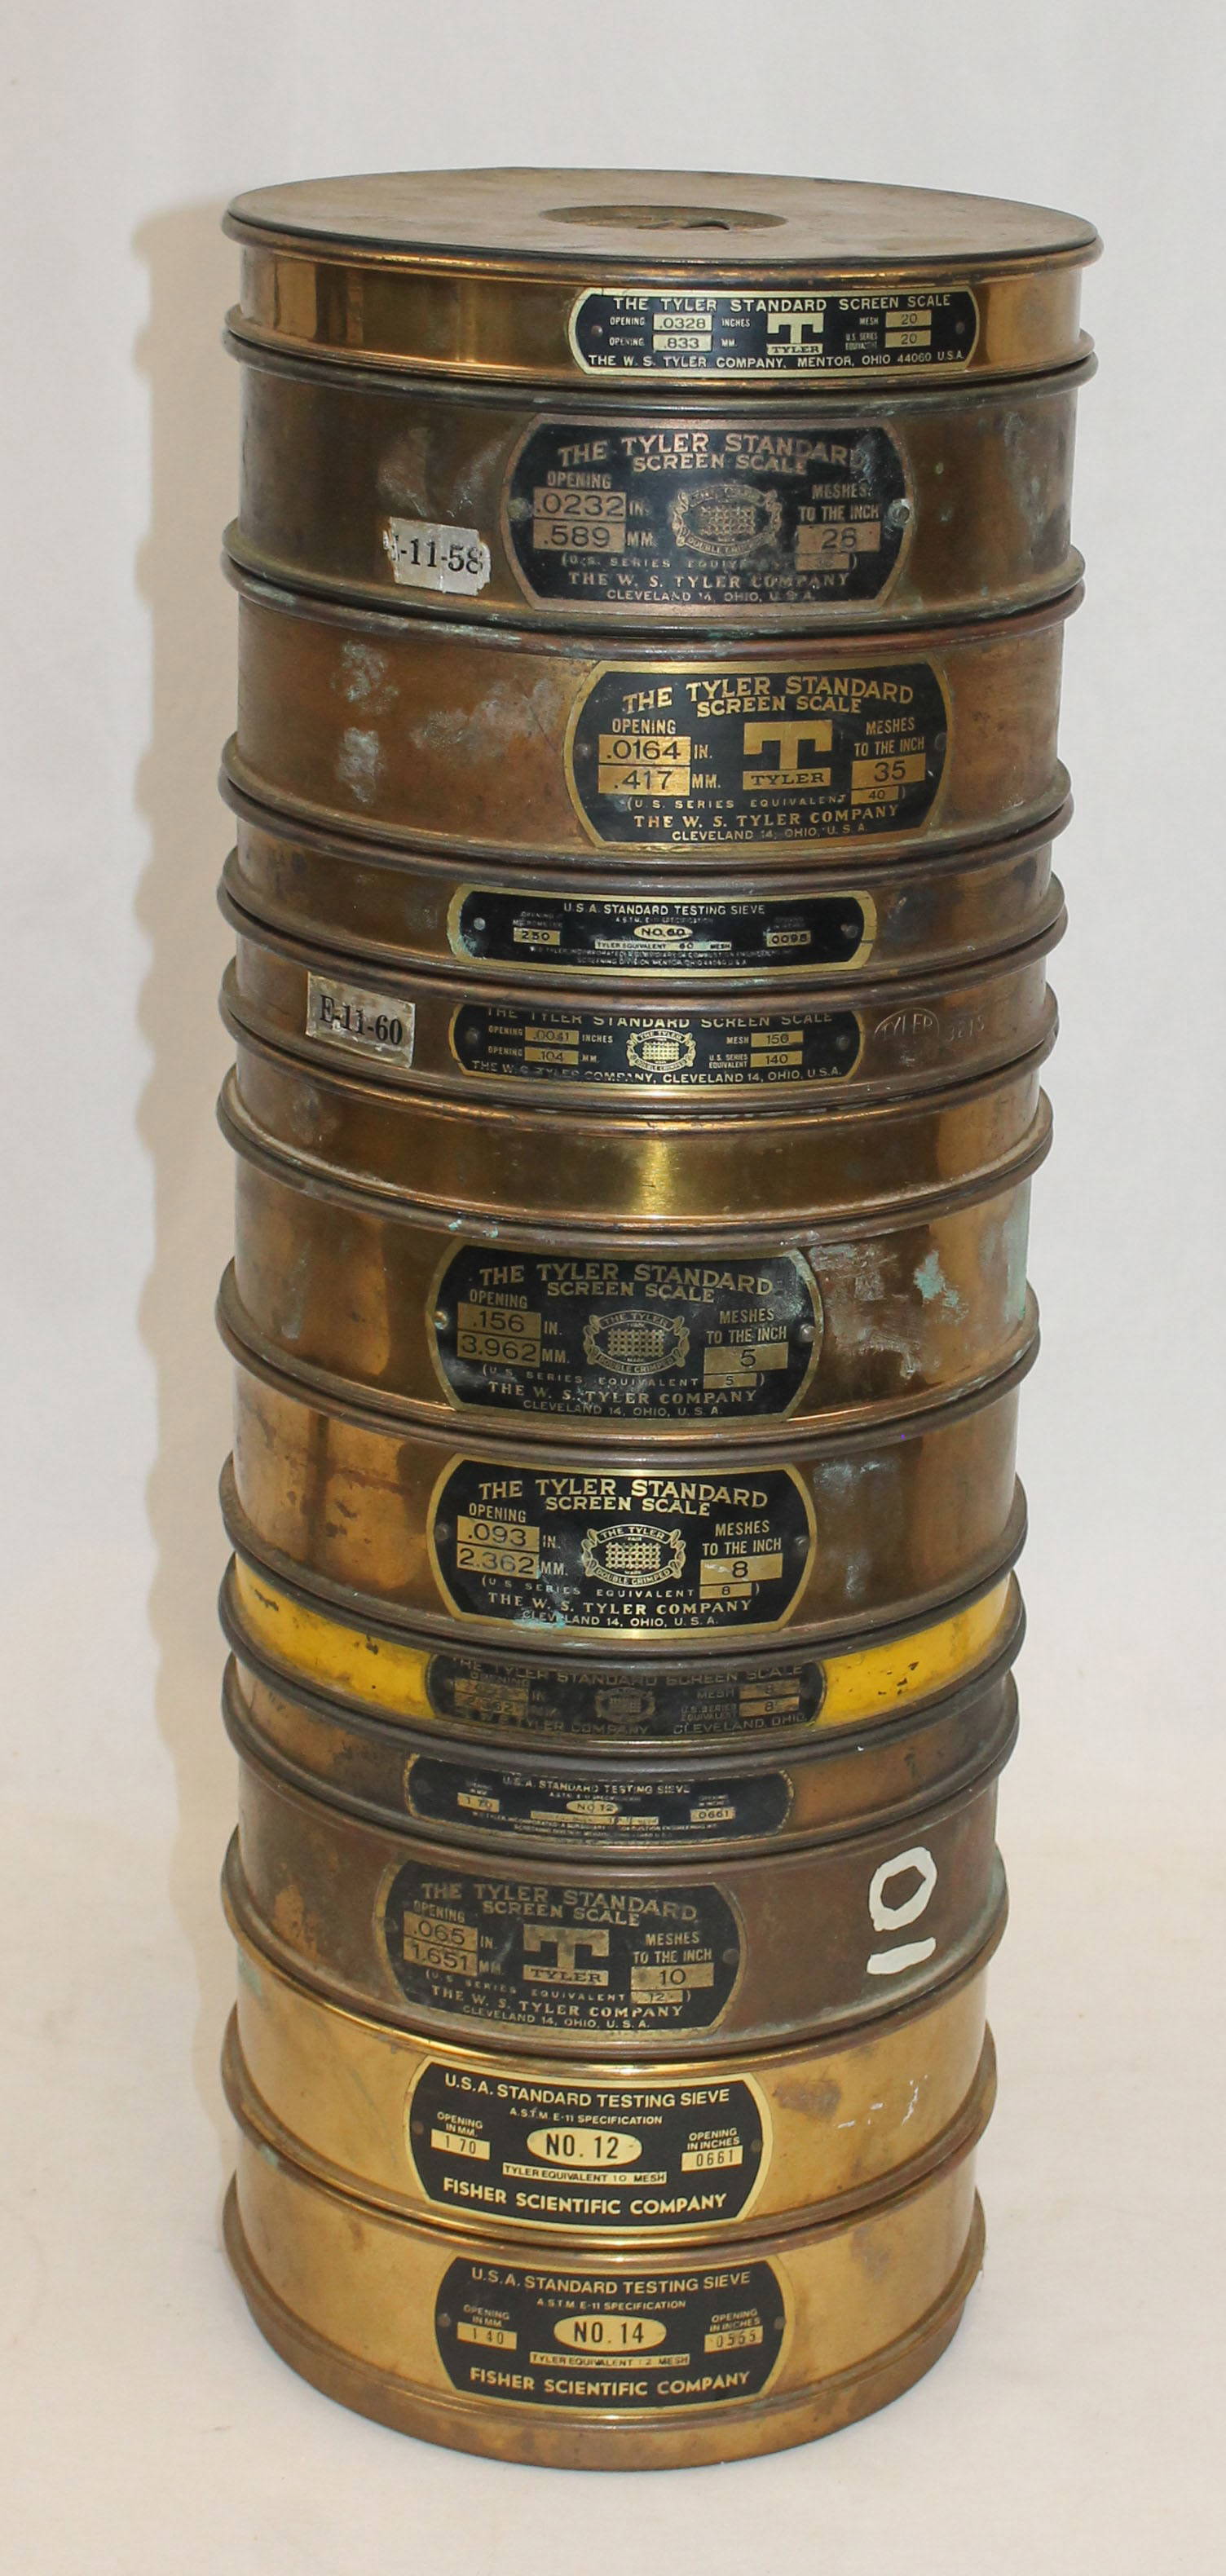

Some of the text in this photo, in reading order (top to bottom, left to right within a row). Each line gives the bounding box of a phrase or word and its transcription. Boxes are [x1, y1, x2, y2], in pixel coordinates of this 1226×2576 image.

[613, 295, 950, 312] THE TYLER STANDARD SCREEN SCALE
[610, 317, 750, 329] OPENING .0328 INCHES
[859, 312, 917, 325] MESH 20
[900, 333, 917, 345] 20
[589, 353, 931, 368] THE TYLER OHIO 44060
[558, 434, 709, 466] THE TYLER
[633, 457, 808, 475] SCREEN SCALE
[546, 471, 611, 488] OPENING
[536, 494, 623, 517] .0232
[798, 504, 879, 521] TO THE INCH
[544, 525, 611, 547] .589
[392, 535, 483, 574] -11-58
[570, 572, 740, 588] THE TYLER
[623, 676, 913, 714] THE TYLER STANDARD
[697, 695, 861, 717] SCREEN SCALE
[612, 718, 677, 733] OPENING
[866, 717, 915, 734] MESHES
[606, 740, 712, 760] .0164 IN.
[854, 737, 924, 756] TO THE INCH
[614, 770, 721, 789] .417 MM.
[751, 773, 824, 786] TYLER
[874, 761, 906, 782] 35
[869, 790, 884, 801] 40
[634, 805, 898, 828] THE TYLER COMPANY
[672, 830, 752, 842] CLEVELAND
[603, 904, 668, 915] STANDARD
[674, 906, 725, 915] TESTING
[730, 905, 765, 915] SIEVE
[522, 931, 550, 941] 250
[320, 995, 402, 1045] E-11-60
[726, 1034, 789, 1044] MESH 150
[488, 1046, 522, 1056] OPENING
[765, 1053, 787, 1065] 140
[671, 1070, 743, 1083] CLEVELAND
[480, 1264, 774, 1295] THE TYLER STANDARD
[470, 1289, 528, 1308] OPENING
[547, 1281, 715, 1303] SCREEN SCALE
[473, 1311, 525, 1331] .156
[719, 1308, 774, 1324] MESHES
[707, 1327, 787, 1343] TO THE INCH
[461, 1335, 537, 1361] 3.962
[740, 1349, 756, 1366] 5
[489, 1381, 756, 1405] THE TYLER COMPANY
[523, 1400, 602, 1415] CLEVELAND
[479, 1479, 768, 1509] THE TYLER STANDARD
[469, 1504, 526, 1523] OPENING
[546, 1496, 711, 1516] SCREEN SCALE
[468, 1523, 526, 1546] .093
[715, 1520, 770, 1536] MESHES
[703, 1538, 781, 1556] TO THE INCH
[460, 1549, 534, 1575] 2.362
[732, 1560, 748, 1577] 8
[721, 1586, 730, 1595] 8
[488, 1593, 752, 1615] THE TYLER COMPANY
[421, 1883, 697, 1921] THE TYLER STANDARD
[867, 1846, 937, 1974] 10
[413, 1900, 465, 1923] OPENING
[483, 1900, 639, 1927] SCREEN SCALE
[413, 1921, 465, 1945] .065
[646, 1931, 699, 1945] MESHES
[633, 1948, 712, 1964] TO THE INCH
[531, 1968, 602, 1983] TYLER
[659, 1969, 686, 1986] 10
[462, 2006, 536, 2023] CLEVELAND
[519, 2000, 683, 2018] TYLER COMPANY
[444, 2073, 730, 2109] U.S.A. STANDARD TESTING SIEVE
[437, 2111, 483, 2130] OPENING
[578, 2114, 663, 2125] SPECIFICATION
[689, 2128, 738, 2141] OPENING
[459, 2138, 477, 2155] 70
[594, 2137, 619, 2159] 12
[696, 2150, 734, 2167] 0661
[505, 2165, 665, 2183] TYLER EQUIVALENT 10 MESH
[443, 2177, 726, 2214] FISHER SCIENTIFIC COMPANY
[472, 2267, 751, 2294] U.S.A. STANDARD TESTING SIEVE
[604, 2300, 686, 2310] SPECIFICATION
[712, 2309, 757, 2322] OPENING
[574, 2321, 644, 2344] NO. 14
[470, 2367, 750, 2396] FISHER SCIENTIFIC COMPANY
